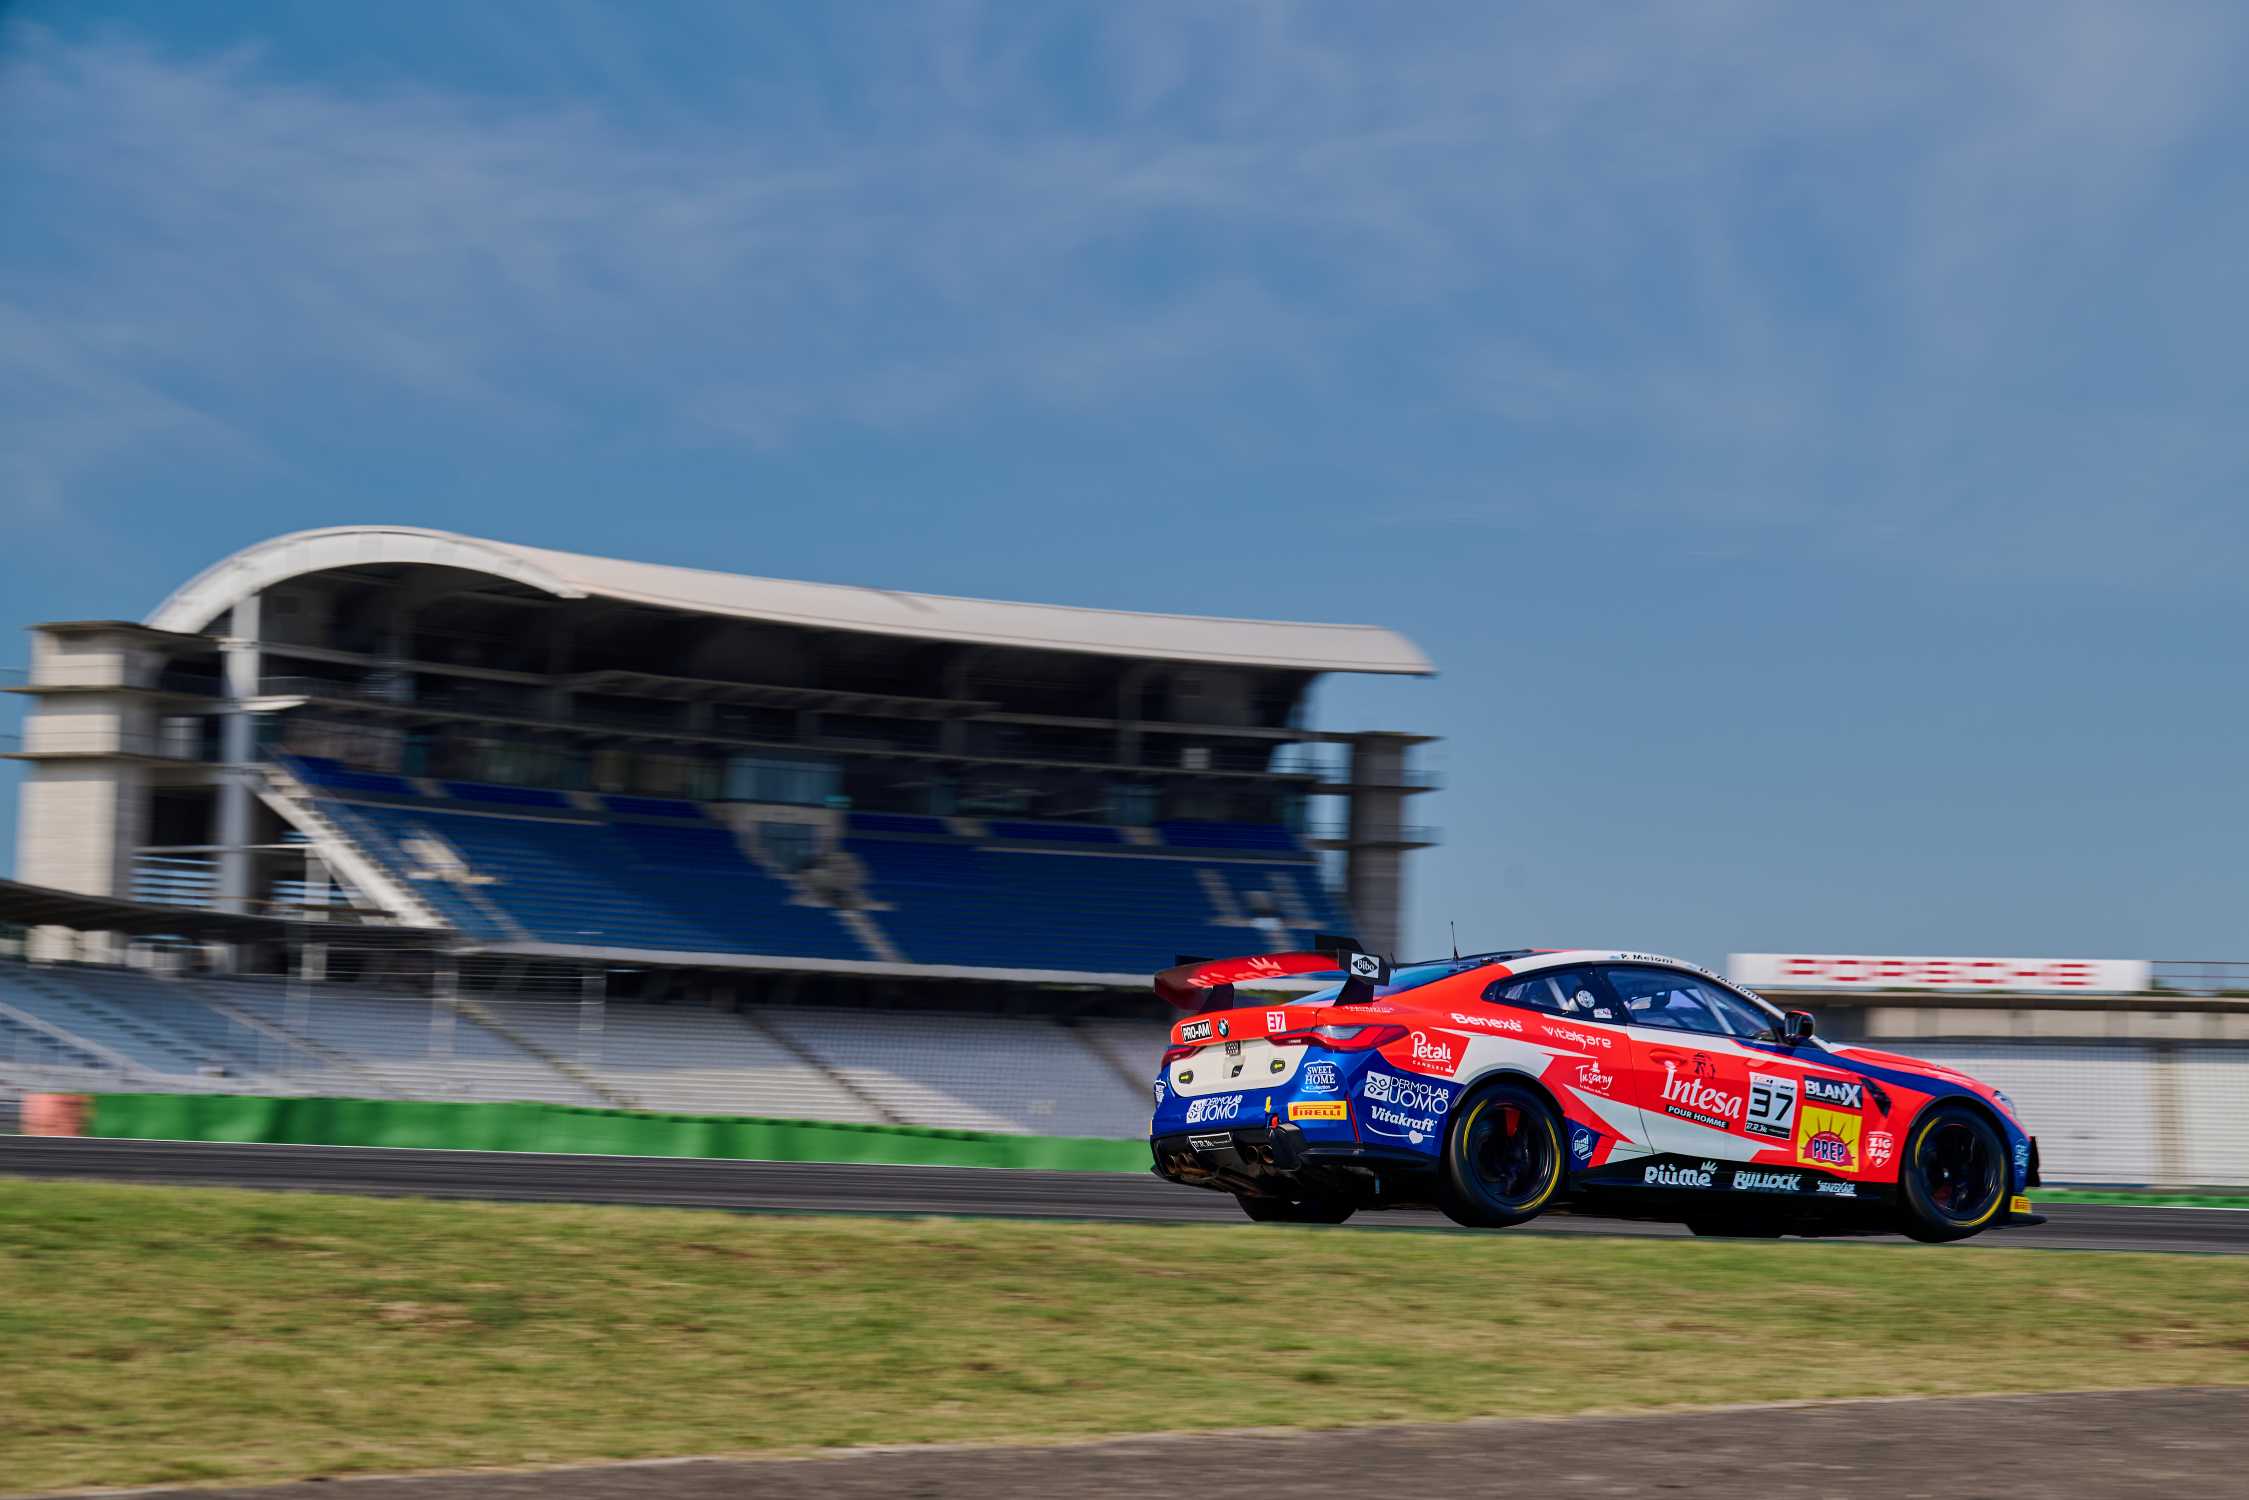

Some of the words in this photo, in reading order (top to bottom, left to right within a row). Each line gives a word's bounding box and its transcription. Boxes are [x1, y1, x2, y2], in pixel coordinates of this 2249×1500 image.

[1782, 958, 2098, 986] PORSCHE
[1182, 1024, 1211, 1041] PRO-AM
[1268, 1013, 1284, 1031] 37
[1305, 1073, 1336, 1085] HOME
[1307, 1065, 1333, 1076] SWEET
[1575, 1064, 1613, 1090] Tuscany
[1391, 1077, 1449, 1099] DERMOLAB
[1660, 1060, 1742, 1119] Intesa
[1200, 1103, 1239, 1122] UOMO
[1293, 1104, 1341, 1118] PIRELLI
[1389, 1090, 1449, 1115] UOMO
[1749, 1087, 1793, 1121] 37
[1371, 1105, 1435, 1132] Vitakraft
[1668, 1105, 1692, 1119] POUR
[1693, 1113, 1727, 1128] HOMME
[1813, 1138, 1844, 1163] PREP
[1868, 1147, 1891, 1159] ZAG
[1869, 1137, 1892, 1149] ZIG
[1733, 1171, 1802, 1191] BULLOCK
